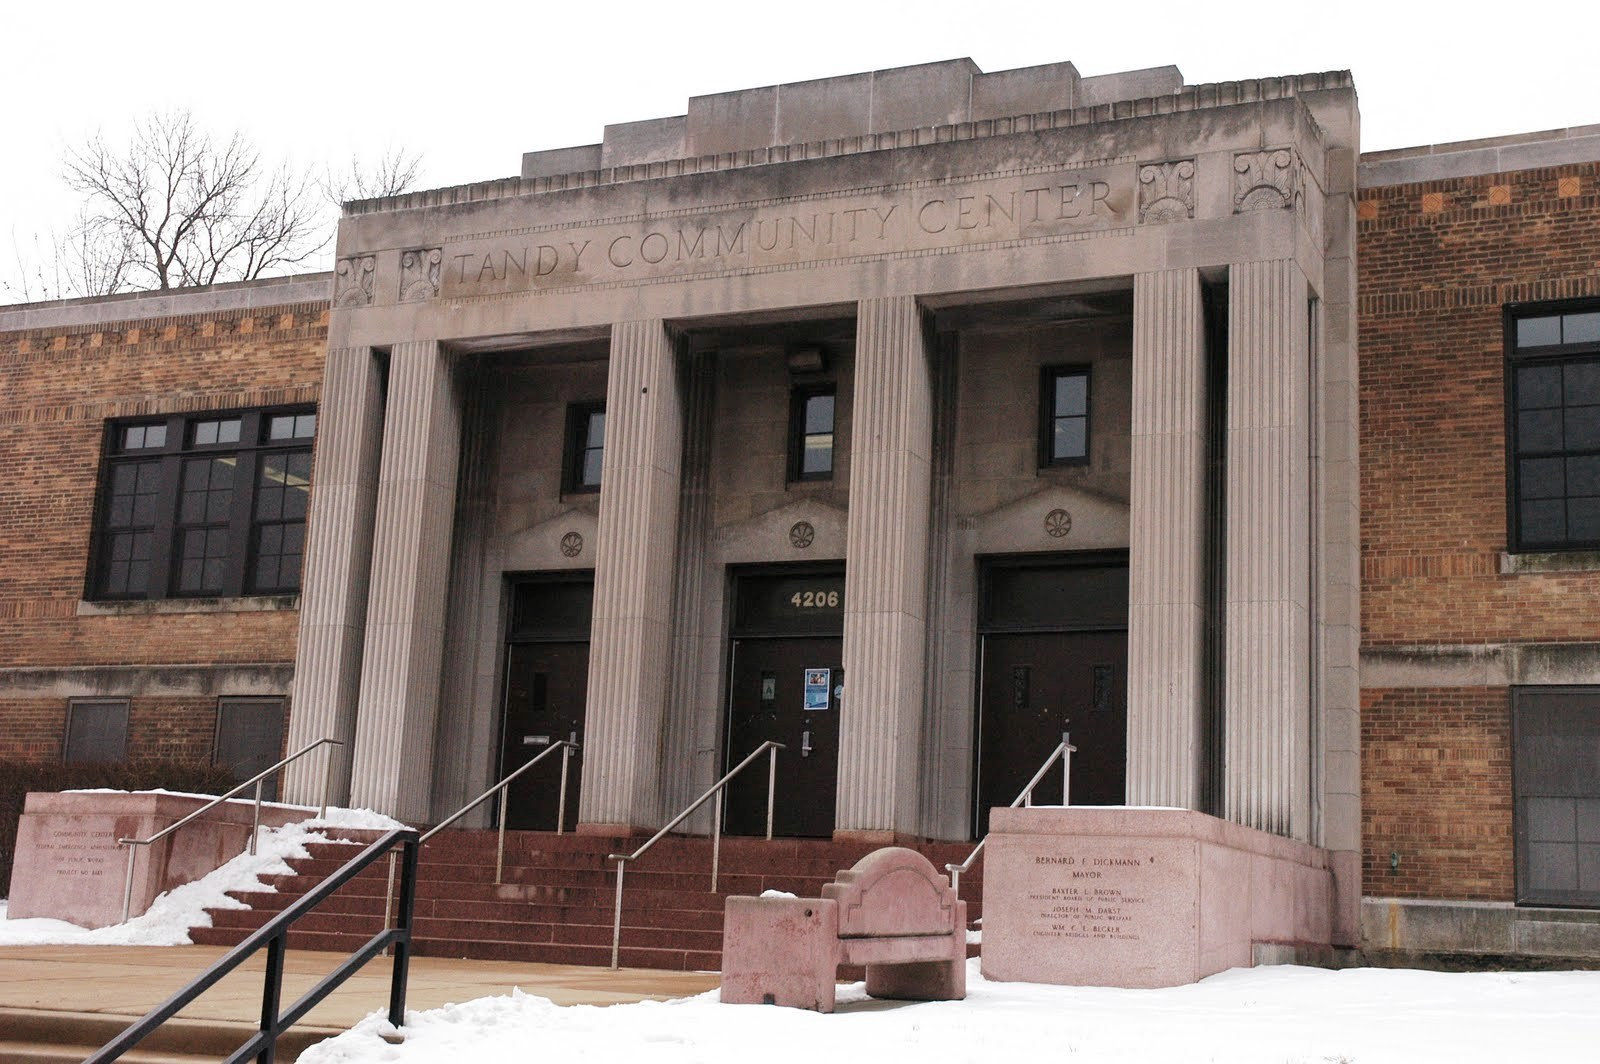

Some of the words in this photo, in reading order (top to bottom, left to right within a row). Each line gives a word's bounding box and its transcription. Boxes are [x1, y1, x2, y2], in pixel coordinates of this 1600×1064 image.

[453, 239, 592, 285] TANDY
[607, 205, 899, 268] COMMUNITY
[917, 180, 1120, 234] CENTER
[791, 591, 839, 608] 4206
[1035, 856, 1075, 865] BERNARD
[1093, 858, 1141, 867] DICKMANN
[1072, 871, 1103, 879] MAYOR
[1051, 887, 1079, 895] BAXTER
[1093, 888, 1122, 896] BROWN
[1052, 906, 1079, 914] JOSEPH
[1097, 907, 1121, 915] DARST
[1092, 925, 1121, 933] BECKER
